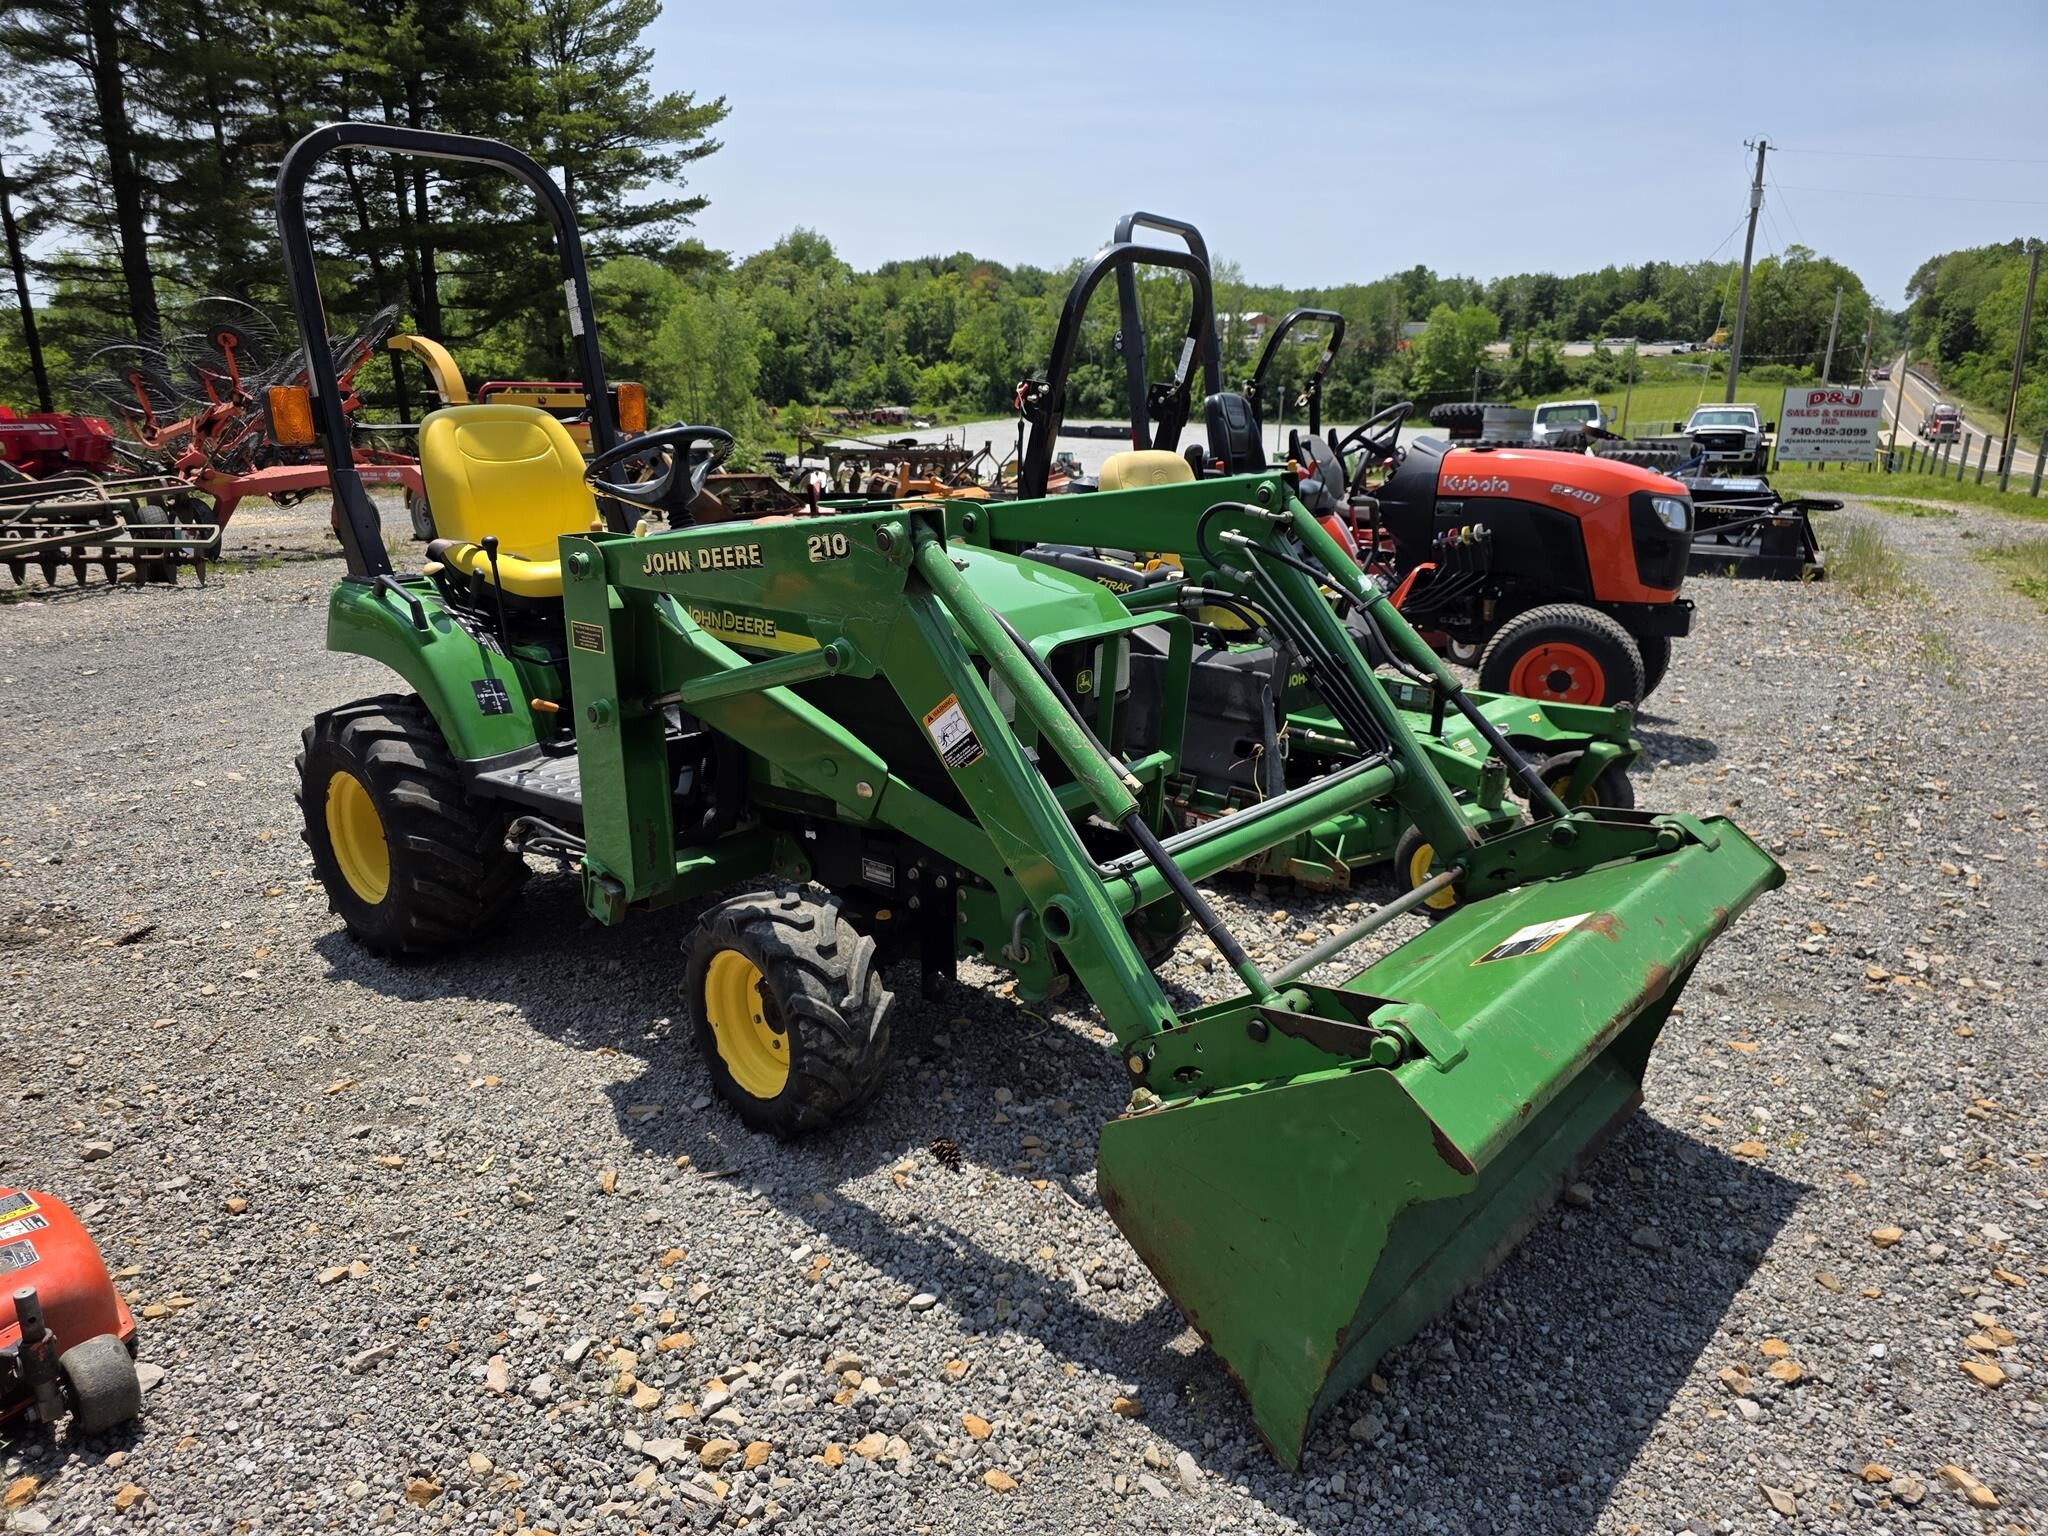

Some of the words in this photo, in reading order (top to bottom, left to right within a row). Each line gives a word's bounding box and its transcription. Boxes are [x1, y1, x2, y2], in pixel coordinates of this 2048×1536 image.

[1807, 390, 1862, 408] D&J
[1785, 409, 1820, 418] SALES
[1821, 409, 1831, 417] &
[1832, 409, 1878, 418] SERVICE
[1791, 428, 1868, 436] 740-942-3099
[1442, 475, 1510, 493] Kubota
[807, 532, 850, 563] 210
[642, 550, 693, 575] JOHN
[698, 544, 763, 570] DEERE
[1097, 576, 1132, 592] ZTRAK
[723, 610, 776, 637] DEERE
[932, 697, 954, 718] WARNING
